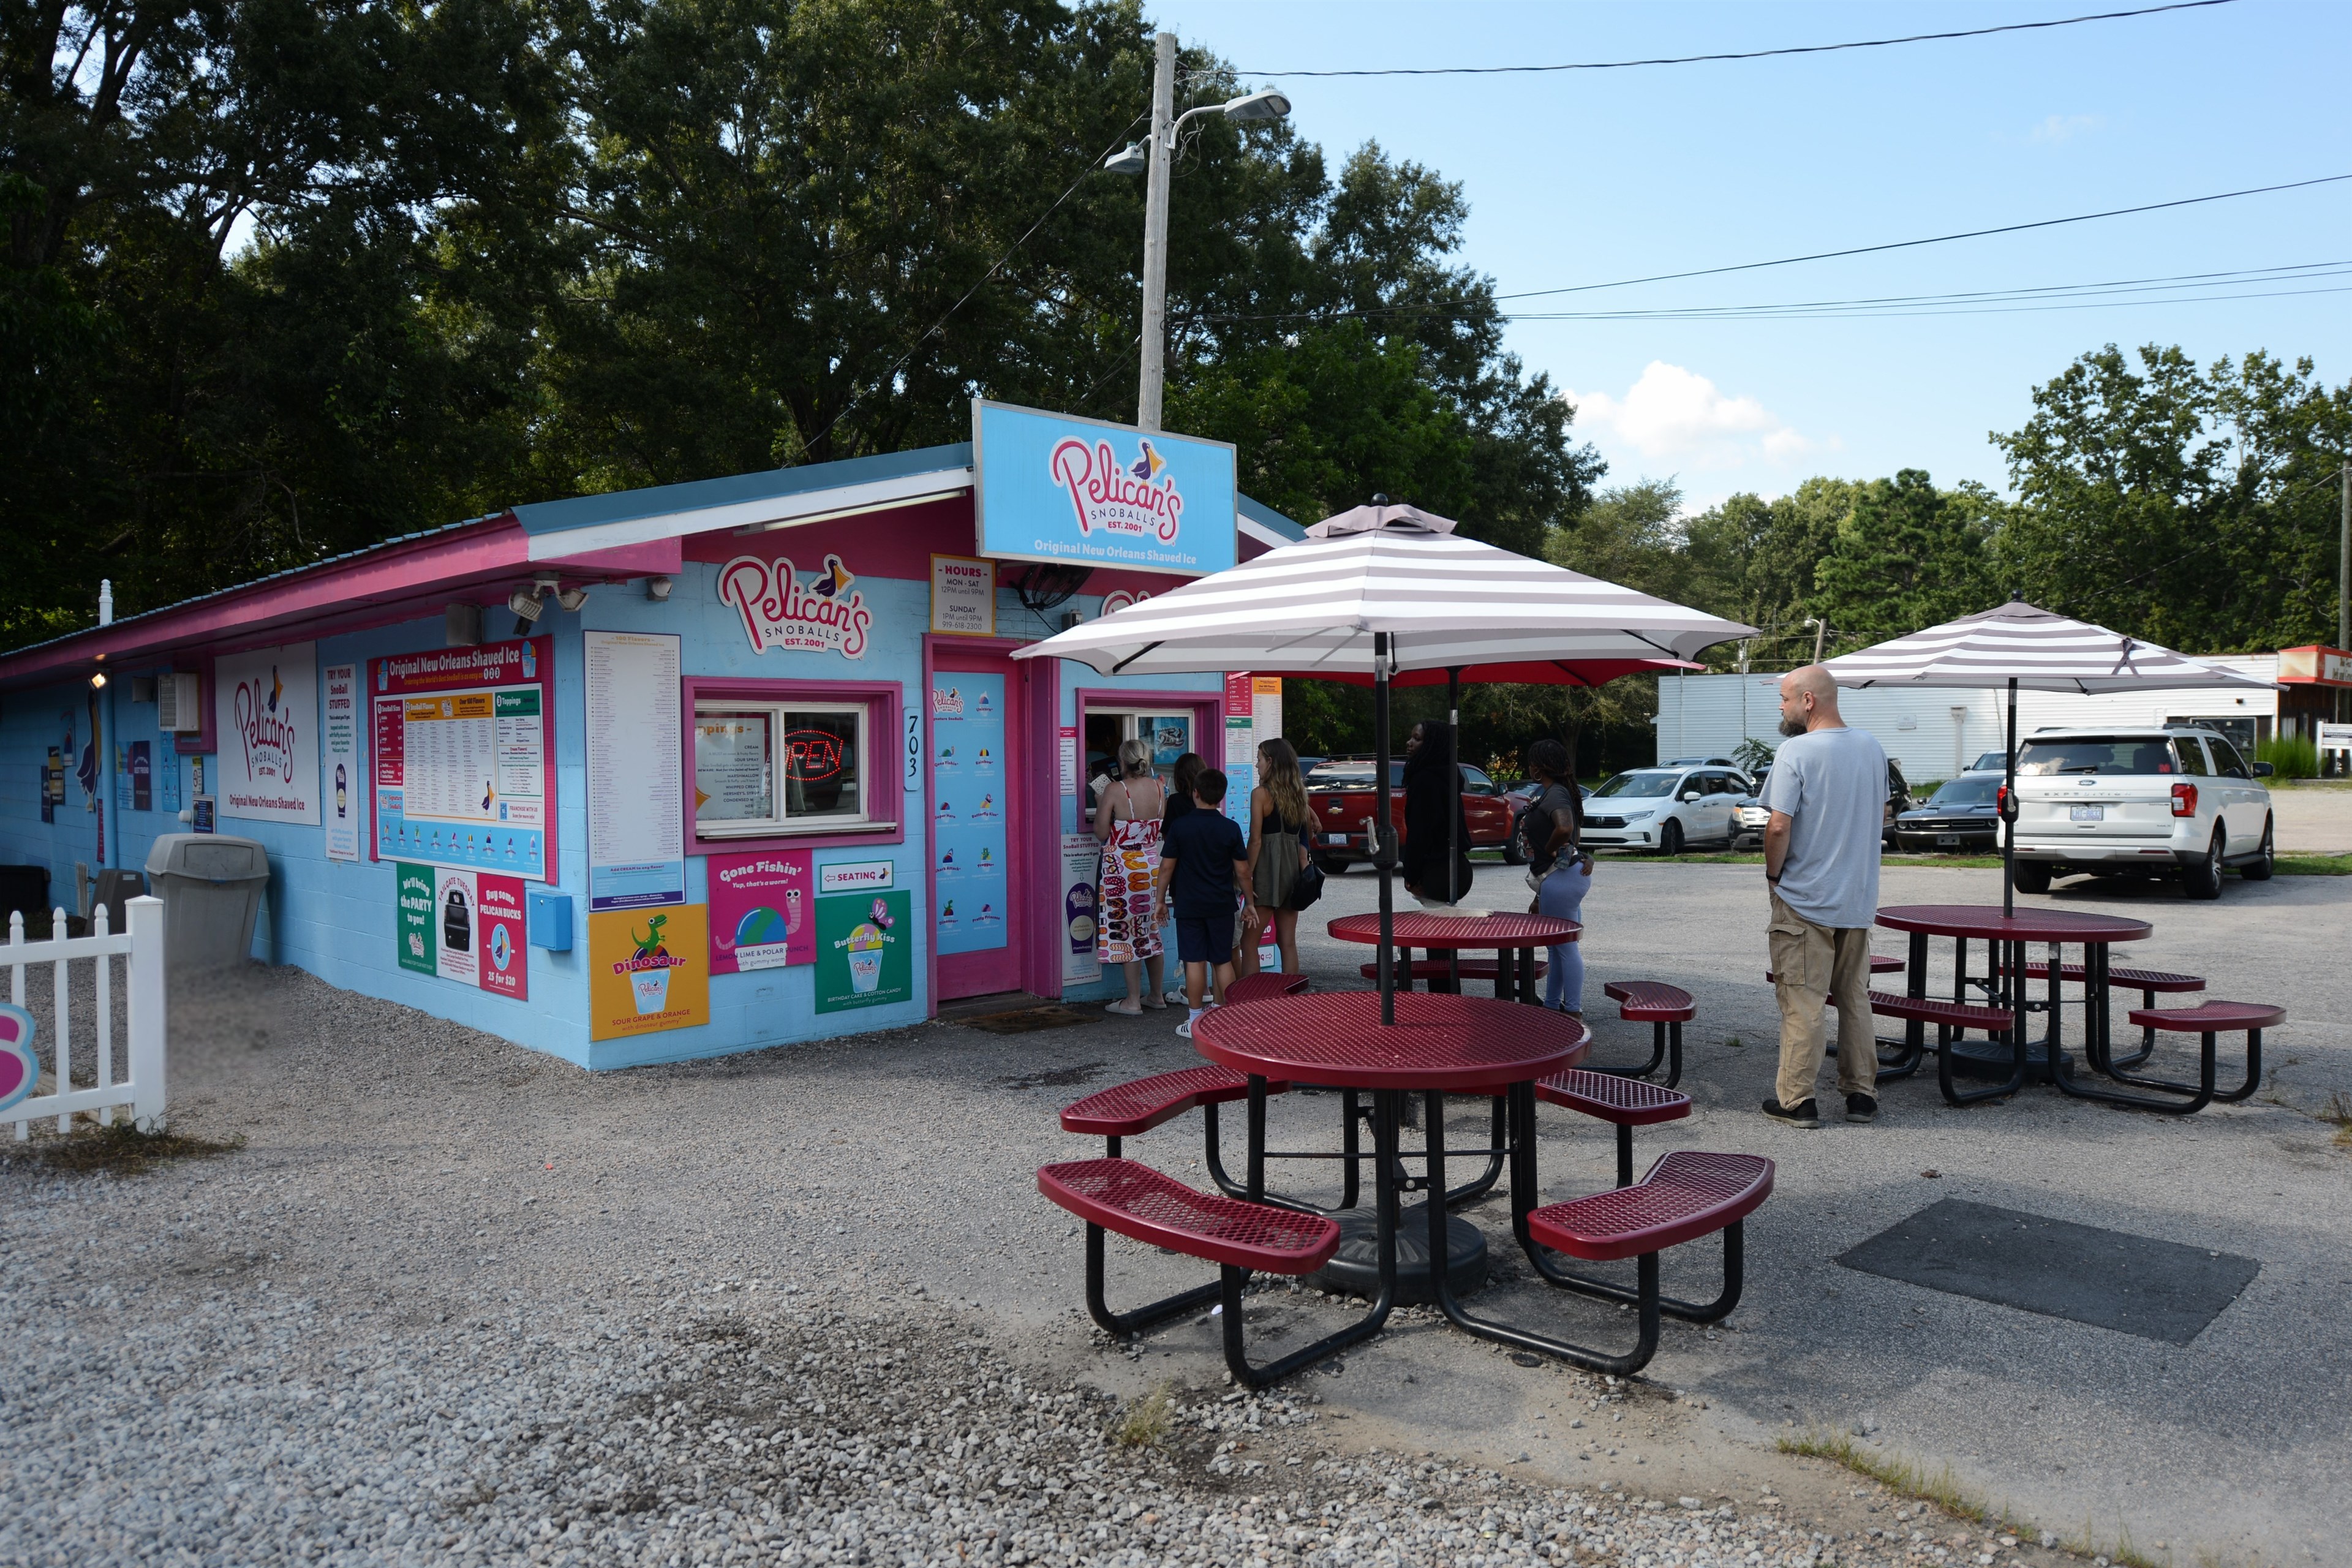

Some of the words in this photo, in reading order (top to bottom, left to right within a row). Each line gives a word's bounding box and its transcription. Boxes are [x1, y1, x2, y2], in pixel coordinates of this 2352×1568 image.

[1053, 440, 1180, 540] Pelican's
[1091, 508, 1155, 526] SNOBALLS
[1125, 522, 1142, 532] 2001
[1035, 540, 1080, 554] Original
[1082, 544, 1104, 556] New
[1107, 546, 1145, 559] Orleans
[1147, 549, 1181, 563] Shaved
[1183, 553, 1196, 564] Ice
[945, 565, 981, 577] HOURS
[723, 561, 869, 654] Pelican's
[766, 625, 839, 641] SNOBALLS
[942, 621, 982, 630] 919-618-2300
[804, 639, 824, 648] 2001
[390, 657, 420, 679] Original
[421, 657, 438, 673] New
[439, 653, 471, 671] Orleans
[472, 646, 504, 667] Shaved
[506, 647, 519, 663] Ice
[337, 668, 351, 679] YOUR
[331, 684, 348, 695] SnoBall
[329, 699, 350, 709] STUFFED
[502, 696, 521, 706] Toppings
[933, 690, 963, 713] Pelican's
[235, 678, 295, 783] Pelican's
[695, 724, 744, 735] ppings
[908, 715, 918, 777] 703
[252, 751, 282, 767] SNOBALLS
[266, 767, 276, 777] 2001
[229, 794, 247, 808] Original
[249, 796, 258, 807] New
[258, 796, 277, 809] Orleans
[278, 797, 296, 810] Shaved
[720, 865, 754, 882] Gone
[756, 861, 802, 876] Fishin'
[838, 871, 875, 881] SEATING
[403, 877, 415, 889] We'll
[415, 878, 430, 897] bring
[438, 877, 456, 902] TAILGATE
[457, 878, 475, 907] TUESDAY
[401, 895, 410, 908] the
[410, 897, 432, 912] PARTY
[486, 889, 498, 902] Buy
[499, 891, 515, 905] some
[407, 913, 413, 922] to
[413, 915, 424, 926] you!
[480, 905, 503, 916] PELICAN
[503, 907, 521, 920] BUCKS
[834, 933, 875, 949] Butterfly
[876, 933, 895, 943] Kiss
[715, 952, 738, 962] LEMON
[612, 956, 686, 975] Dinosaur
[853, 962, 876, 976] Pelican's
[488, 971, 494, 981] 25
[496, 973, 504, 984] for
[505, 974, 516, 986] $20
[638, 982, 664, 997] Pelican's
[827, 993, 850, 1003] BIRTHDAY
[633, 1014, 655, 1023] GRAPE
[663, 1009, 690, 1018] ORANGE
[635, 1021, 658, 1030] dinosaur
